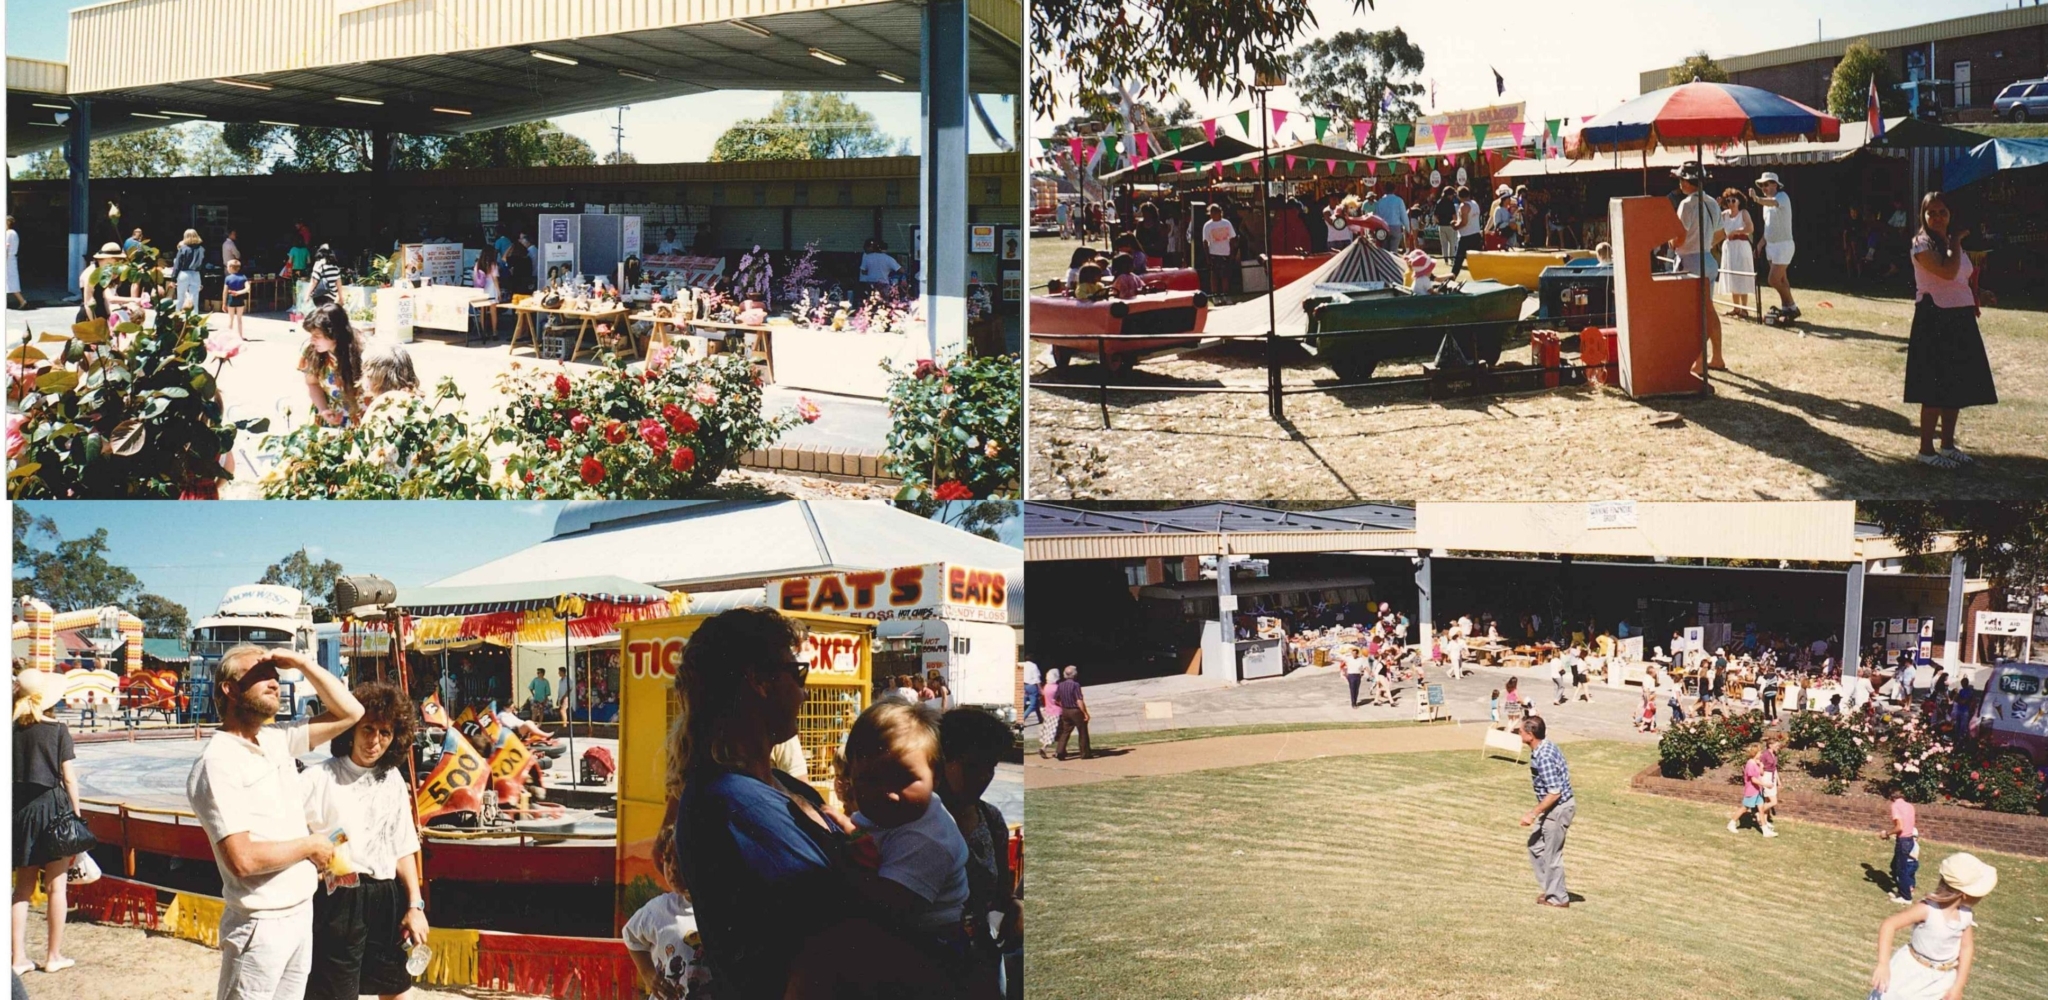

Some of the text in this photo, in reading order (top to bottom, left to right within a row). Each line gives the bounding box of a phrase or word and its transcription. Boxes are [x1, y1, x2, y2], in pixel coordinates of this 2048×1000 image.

[781, 567, 924, 612] EATS
[949, 566, 1006, 609] EATS
[978, 610, 1005, 621] FLOSS
[2002, 676, 2037, 692] Peters
[464, 722, 479, 736] 77
[493, 748, 523, 778] 00
[428, 754, 479, 805] 500
